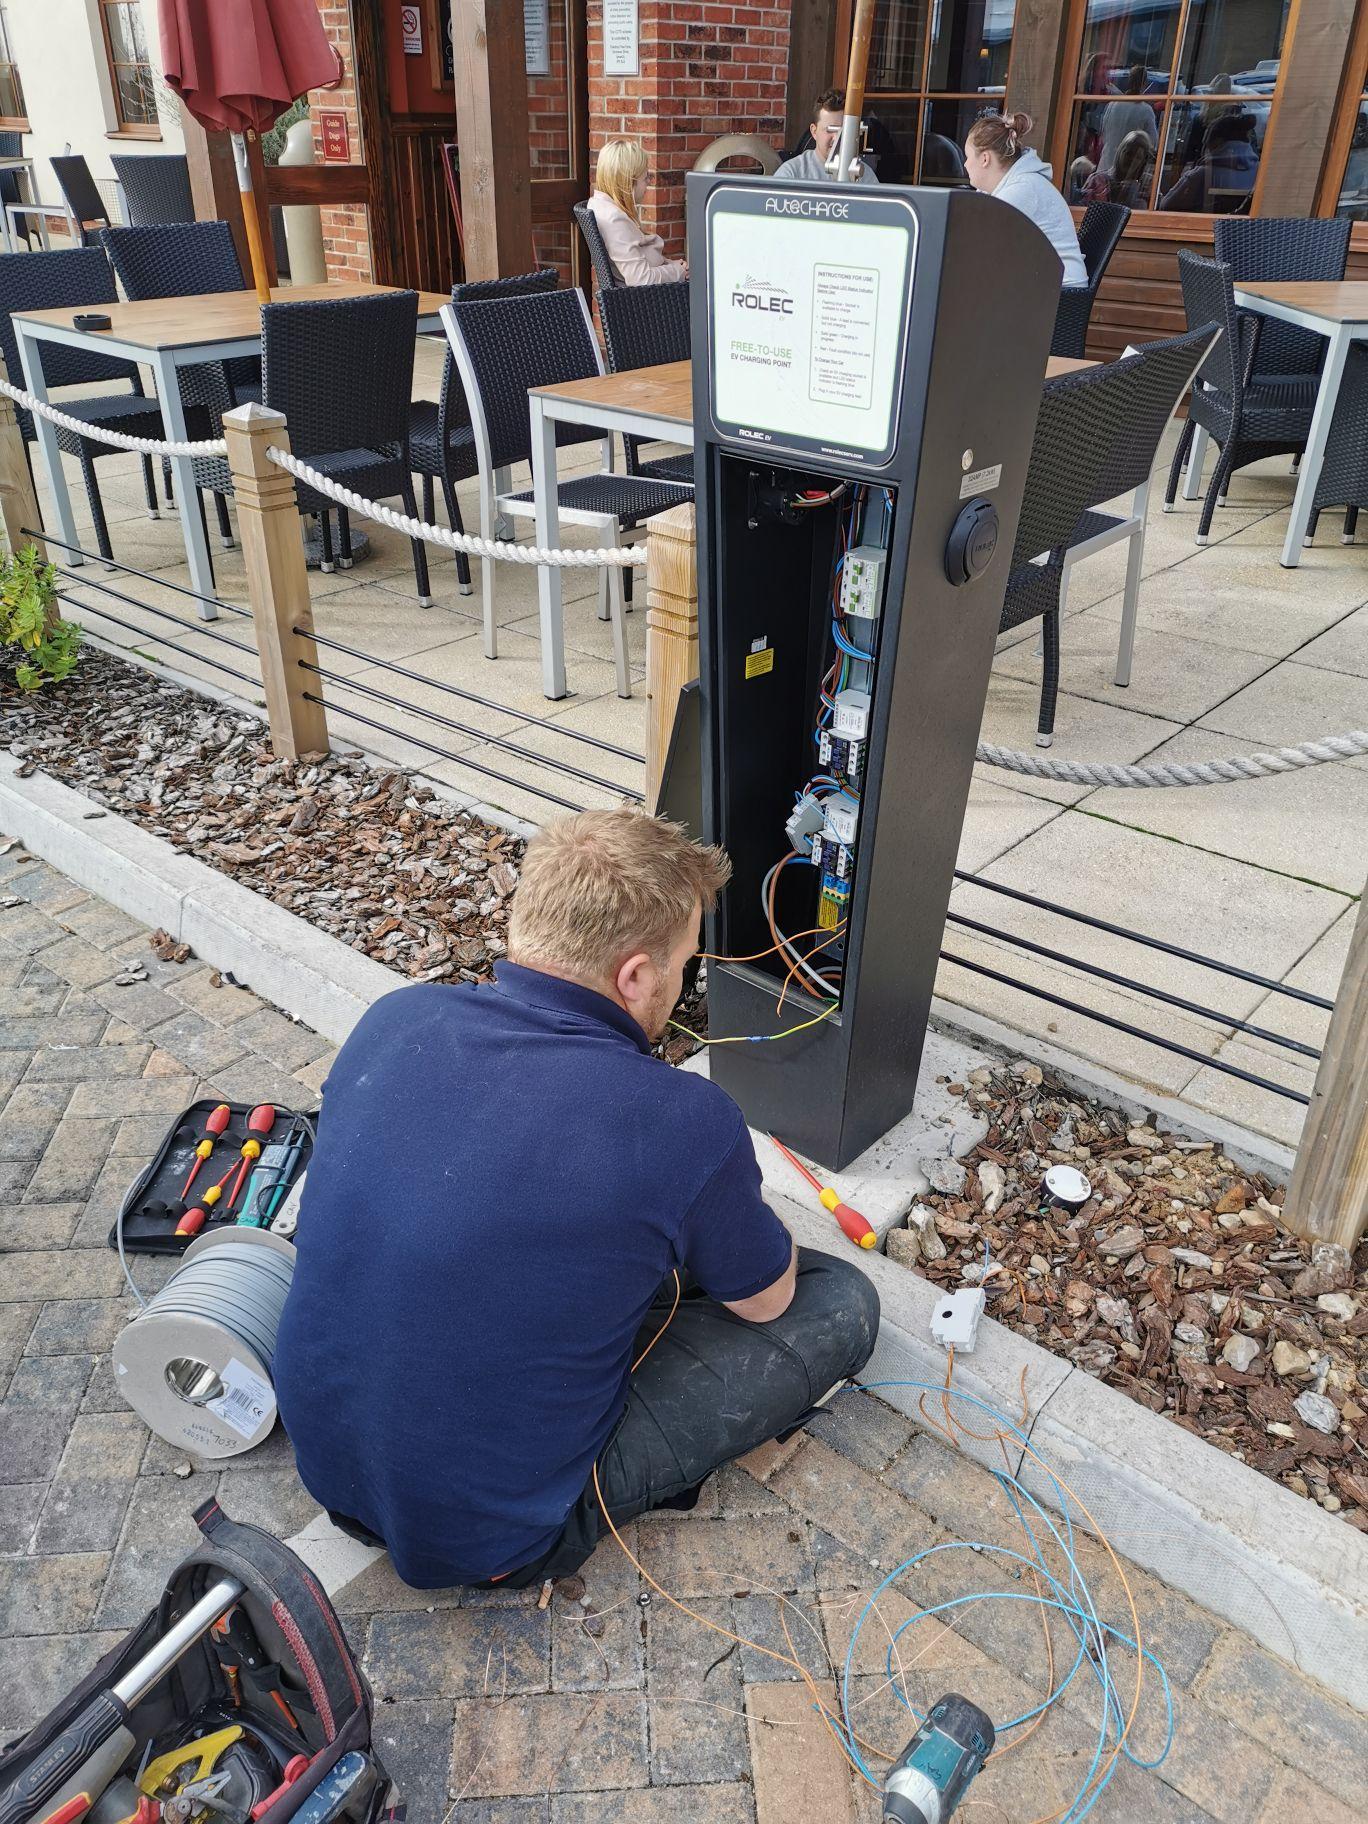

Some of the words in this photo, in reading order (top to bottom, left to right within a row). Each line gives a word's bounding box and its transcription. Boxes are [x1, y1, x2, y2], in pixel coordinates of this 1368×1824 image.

[326, 119, 340, 128] Guide
[328, 131, 341, 142] Dogs
[330, 144, 341, 153] Only
[731, 292, 794, 314] ROLEC
[730, 340, 792, 359] FREE-TO-USE
[739, 354, 772, 366] CHARGING
[772, 359, 792, 369] POINT
[739, 429, 764, 440] ROLEC
[30, 1746, 65, 1783] STANLEY
